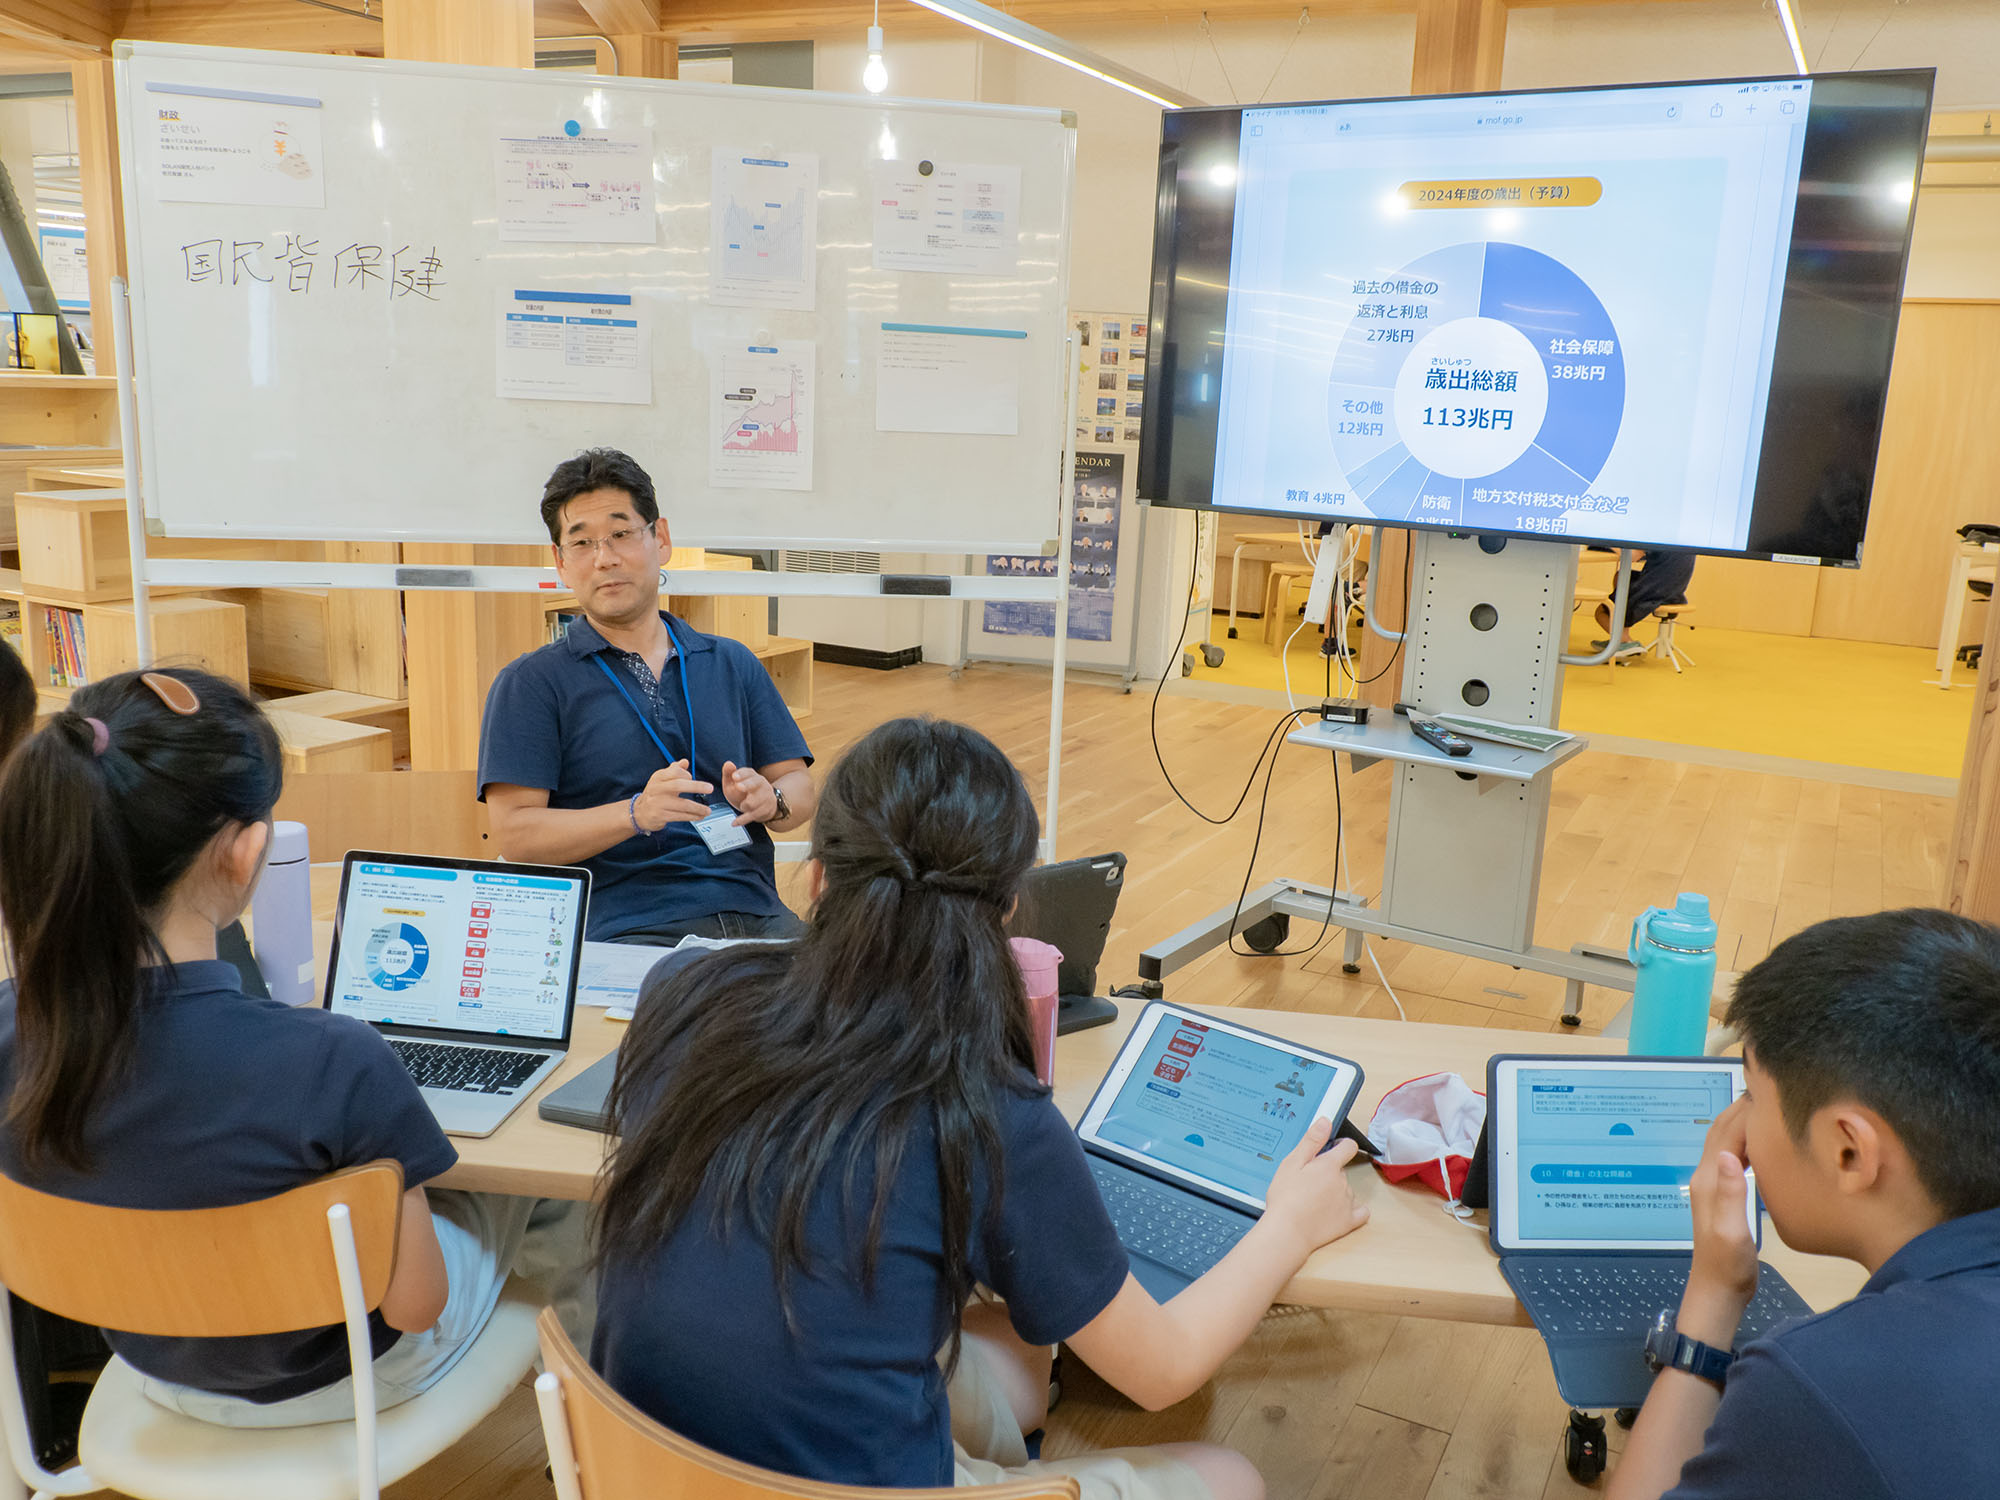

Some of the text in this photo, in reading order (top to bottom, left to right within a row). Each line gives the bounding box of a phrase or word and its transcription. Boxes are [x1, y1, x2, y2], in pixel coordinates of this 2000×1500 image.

[159, 109, 179, 120] 財政
[1485, 114, 1524, 126] mof.go.jp
[160, 123, 201, 135] ざいせい
[1418, 184, 1571, 202] 2024年度の歳出（予算）
[180, 234, 448, 301] 国民皆保健
[1352, 279, 1439, 296] 過去の借金の
[1356, 303, 1429, 320] 返済と利息
[1366, 328, 1415, 344] 27兆円
[1549, 337, 1615, 357] 社会保障
[1430, 356, 1473, 366] さいしゅつ
[1424, 367, 1519, 393] 歳出総額
[1550, 363, 1607, 382] 38兆円
[1341, 399, 1384, 415] その他
[1422, 406, 1514, 431] 113兆円
[1337, 421, 1384, 437] 12兆円
[1075, 456, 1111, 467] ENDAR
[1285, 488, 1346, 506] 教育 4兆円
[1422, 494, 1452, 512] 防衛
[1471, 487, 1631, 515] 地方交付税交付金など
[1514, 515, 1568, 535] 18兆円
